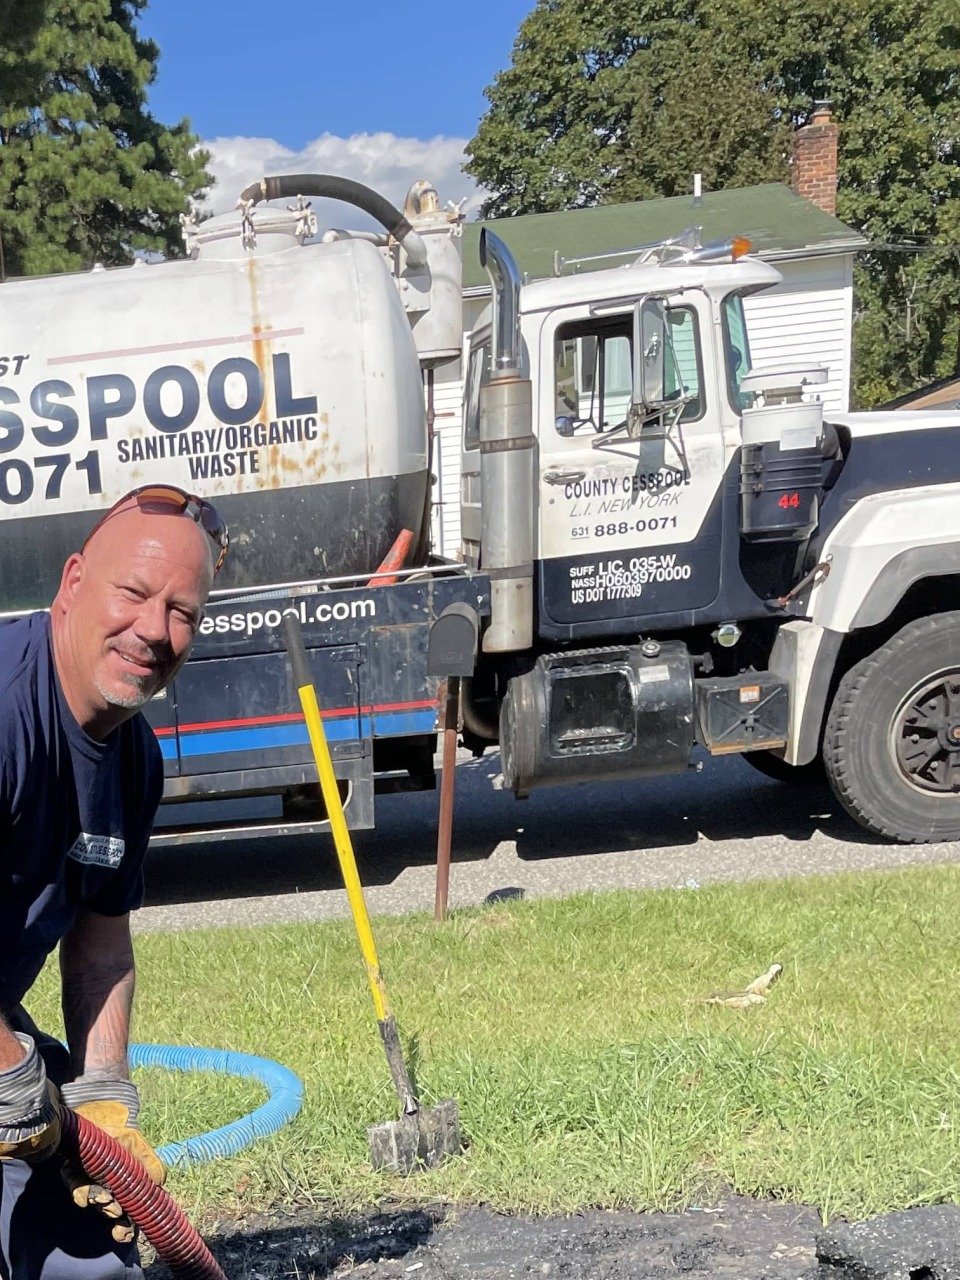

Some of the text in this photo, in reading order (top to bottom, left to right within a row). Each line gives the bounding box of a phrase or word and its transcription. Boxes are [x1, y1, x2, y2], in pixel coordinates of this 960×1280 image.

[117, 416, 319, 464] SANITARY/ORGANIC
[188, 449, 261, 481] WASTE
[564, 469, 691, 500] COUNTY CESSPOOL
[569, 491, 683, 518] L.I. NEW YORK
[778, 492, 799, 509] 44
[571, 515, 678, 538] 631 888-0071
[569, 554, 677, 578] SUFF LIC. 035-W
[571, 577, 595, 589] NASS
[571, 583, 642, 604] US DOT 1777309
